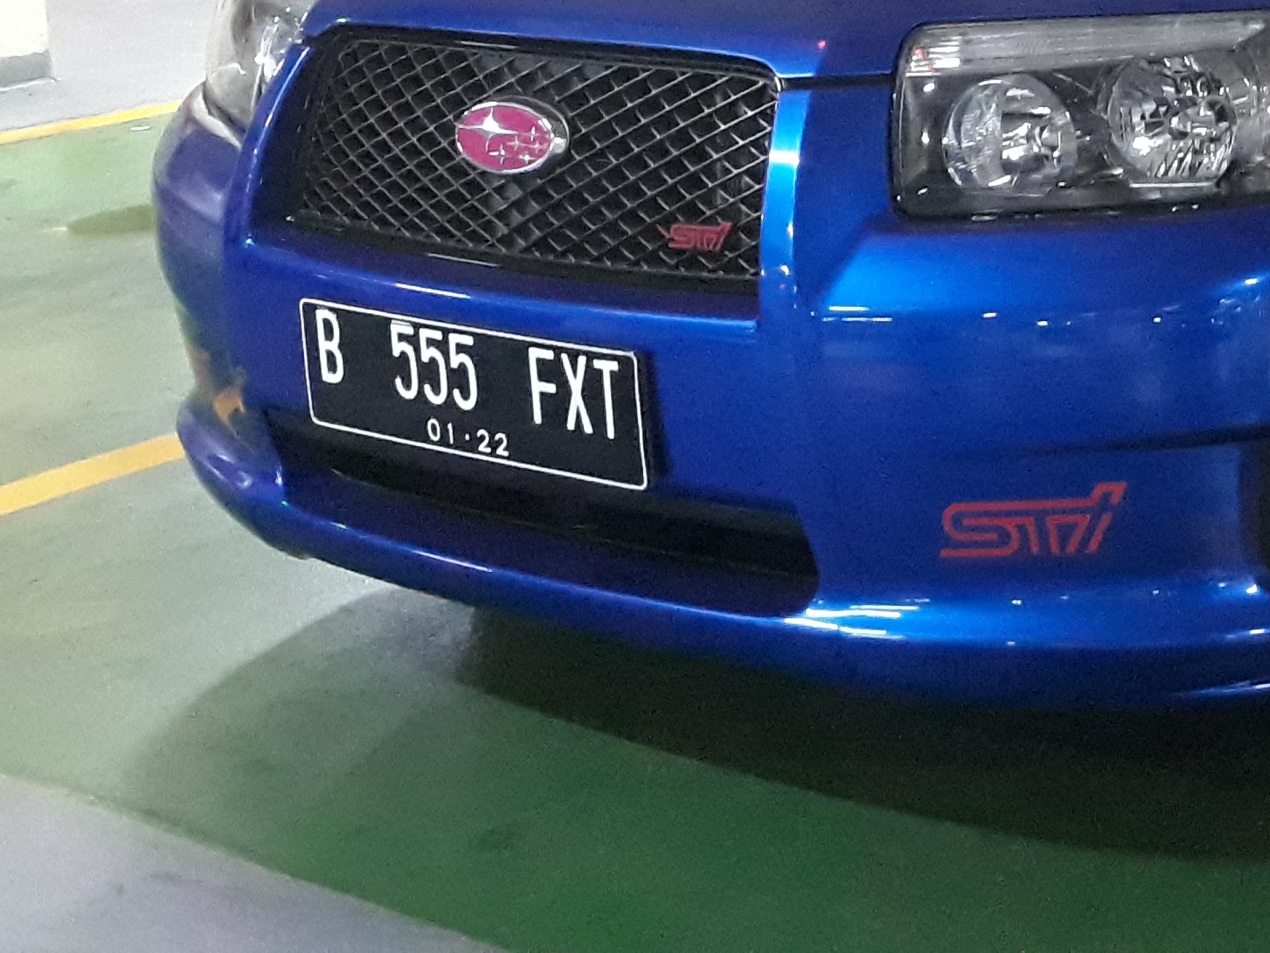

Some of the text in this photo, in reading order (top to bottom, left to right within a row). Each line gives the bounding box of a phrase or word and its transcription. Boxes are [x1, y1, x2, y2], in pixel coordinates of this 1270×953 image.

[315, 307, 619, 440] B 555 FXT
